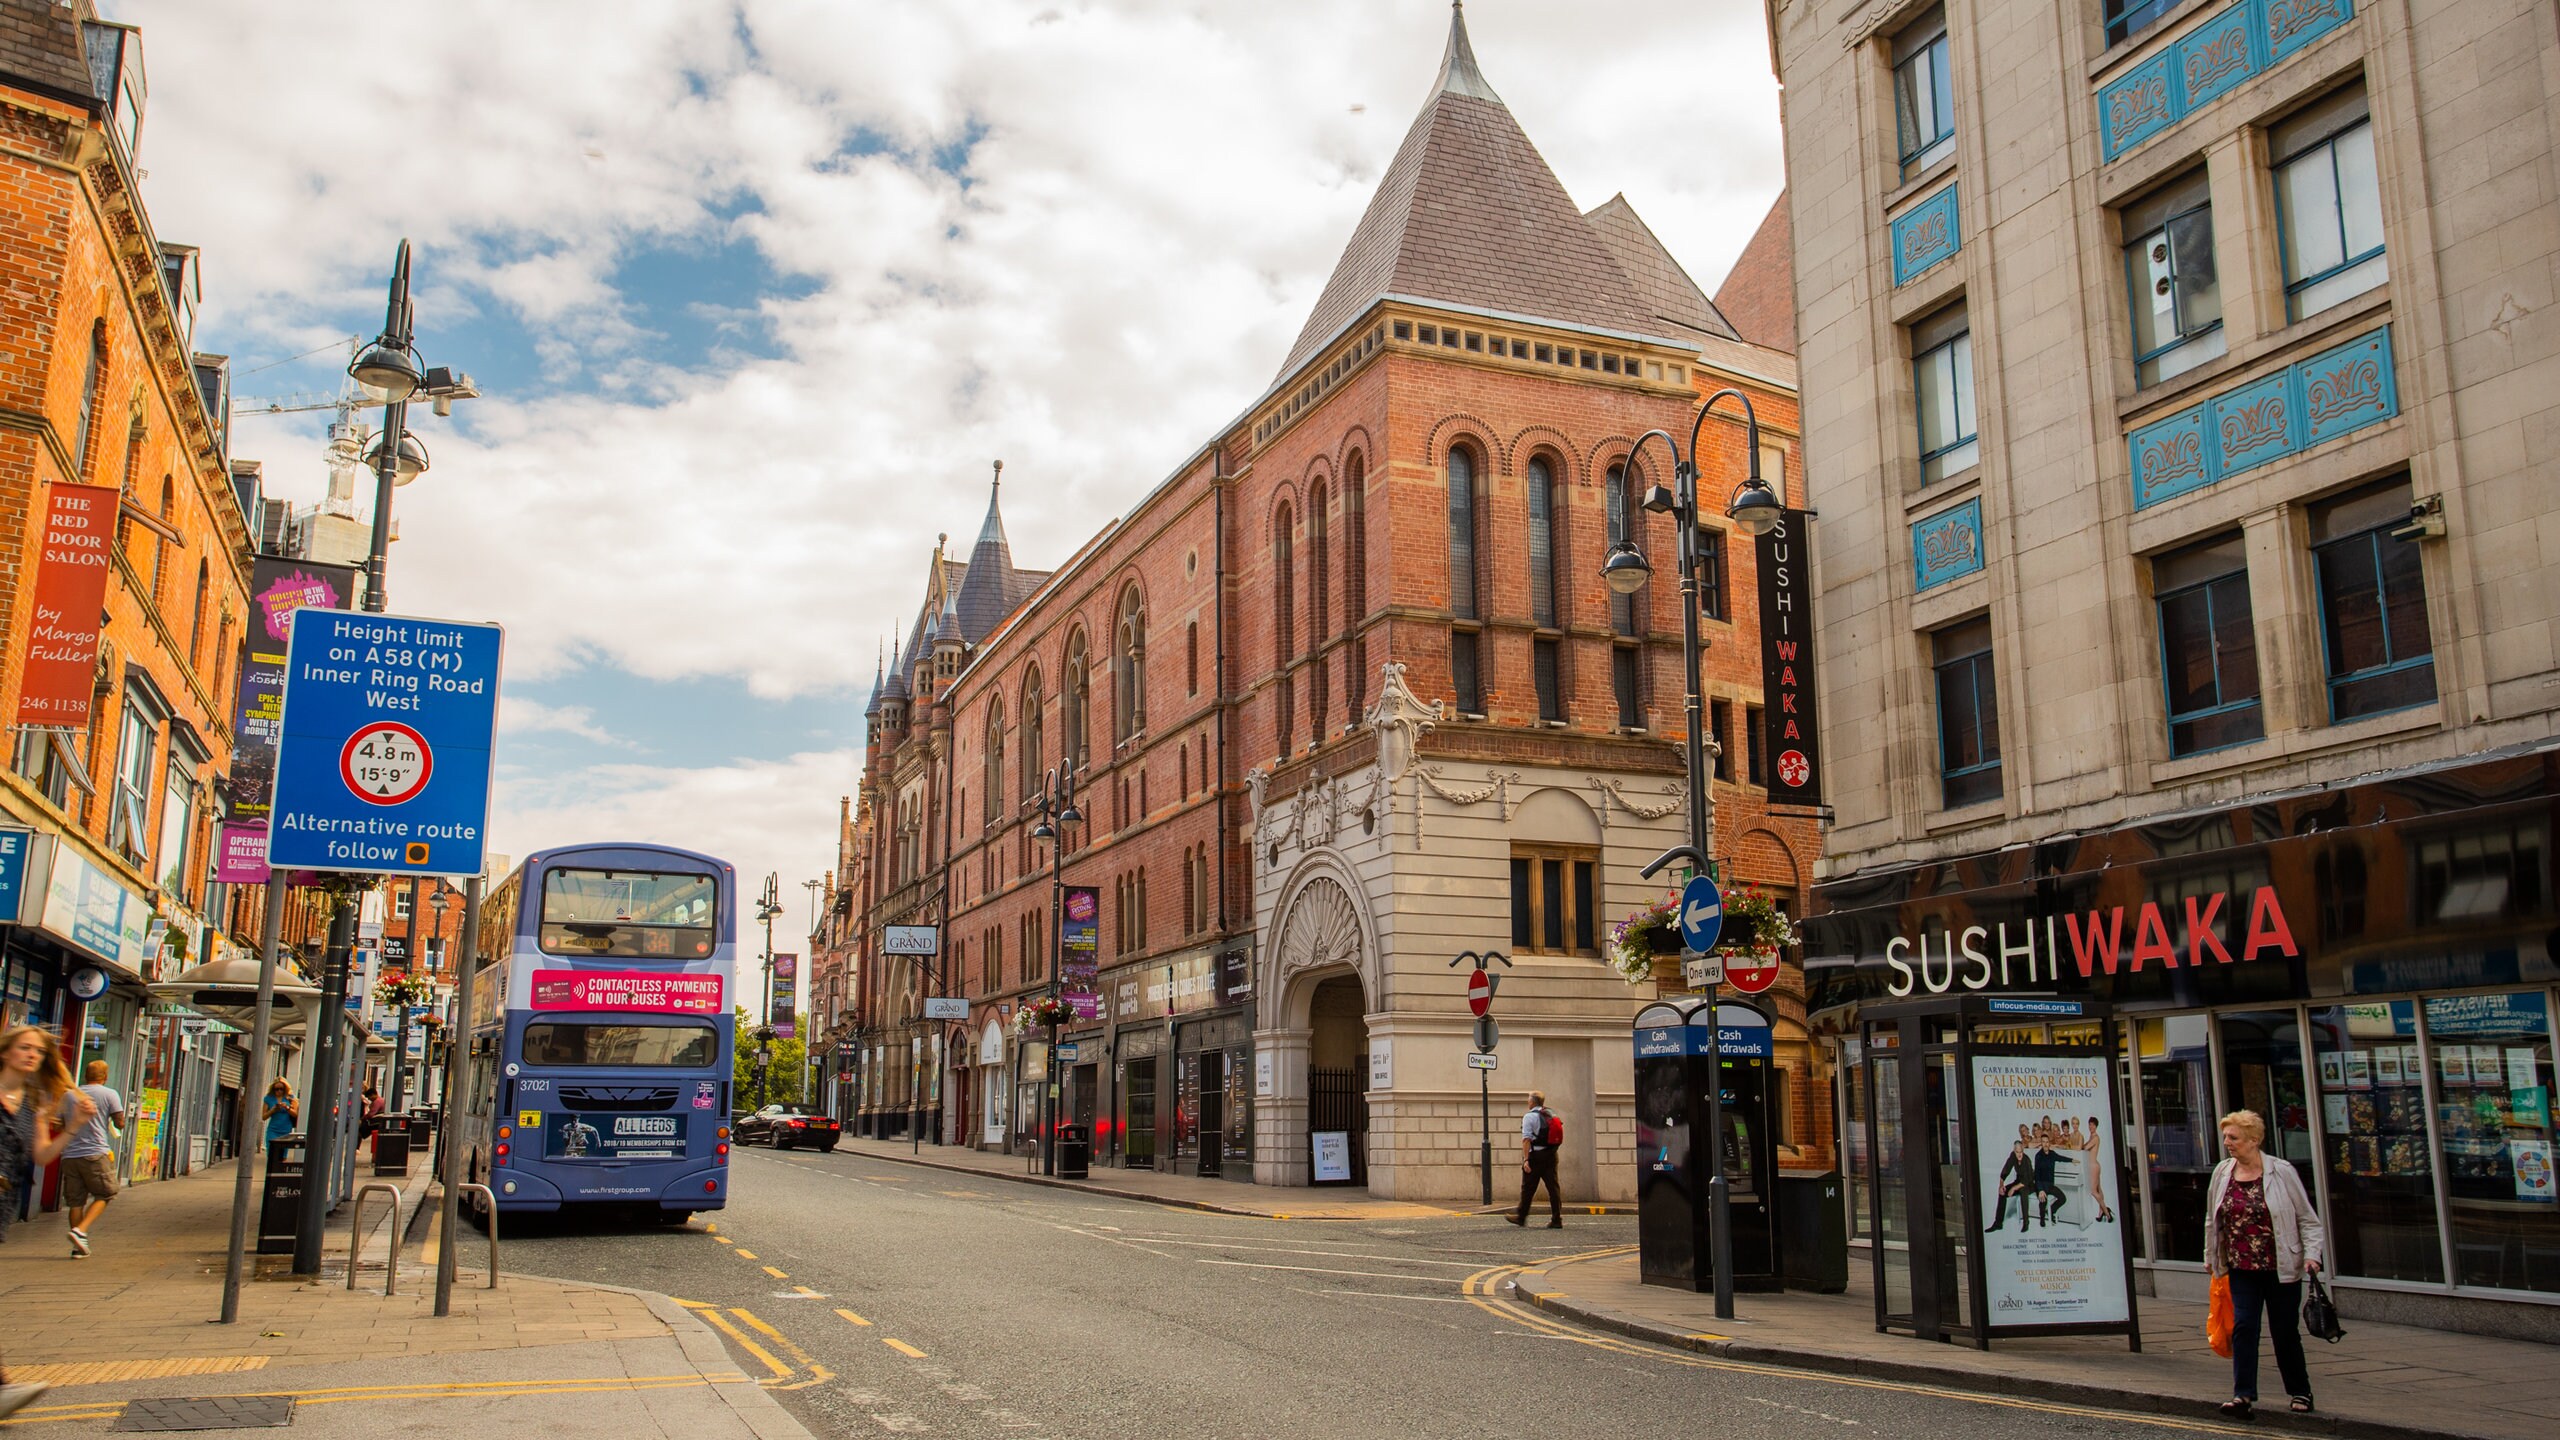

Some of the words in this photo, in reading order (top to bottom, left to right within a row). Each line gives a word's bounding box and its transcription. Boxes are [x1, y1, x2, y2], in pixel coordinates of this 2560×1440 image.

[54, 496, 91, 512] THE
[52, 514, 88, 528] RED
[48, 532, 102, 548] DOOR
[45, 550, 107, 567] SALON
[306, 593, 326, 605] CITY
[37, 604, 62, 624] by
[33, 626, 95, 646] Margo
[334, 620, 408, 644] Height
[416, 628, 464, 648] limit
[30, 645, 94, 663] Fuller
[329, 648, 356, 662] on
[304, 663, 361, 684] Inner
[371, 669, 419, 692] Ring
[429, 674, 484, 694] Road
[22, 696, 48, 710] 246
[54, 698, 87, 712] 1138
[258, 694, 275, 703] EPIC
[366, 690, 421, 711] West
[245, 710, 280, 720] SYMPHON
[249, 718, 268, 728] WITH
[244, 726, 268, 736] ROBIN
[359, 742, 396, 760] 4.8
[401, 750, 416, 762] m
[282, 812, 408, 836] Alternative
[417, 822, 476, 840] route
[328, 840, 398, 860] follow
[890, 937, 932, 948] GRAND
[1688, 968, 1702, 980] One
[1704, 966, 1720, 978] way
[588, 978, 662, 993] CONTACTLESS
[664, 980, 719, 994] PAYMENTS
[588, 992, 603, 1004] ON
[606, 992, 628, 1005] OUR
[632, 994, 666, 1006] BUSES
[1994, 1002, 2077, 1012] infocus-media.org.uk
[1652, 1030, 1667, 1042] Cash
[1718, 1030, 1742, 1040] Cash
[1640, 1042, 1680, 1055] withdrawals
[1470, 1056, 1481, 1064] One
[1982, 1066, 2002, 1074] GARY
[2005, 1066, 2038, 1074] BARLOW
[520, 1080, 550, 1091] 37021
[1983, 1074, 2056, 1088] CALENDAR
[2058, 1075, 2098, 1089] GIRLS
[1990, 1088, 2008, 1097] THE
[2011, 1088, 2044, 1097] AWARD
[2046, 1088, 2092, 1098] WINNING
[2016, 1098, 2068, 1110] MUSICAL
[616, 1118, 636, 1132] ALL
[580, 1186, 650, 1195] www.firstgroup.com
[1826, 1186, 1835, 1198] 14
[2040, 1282, 2072, 1290] MUSICAL
[1998, 1300, 2023, 1308] GRAND
